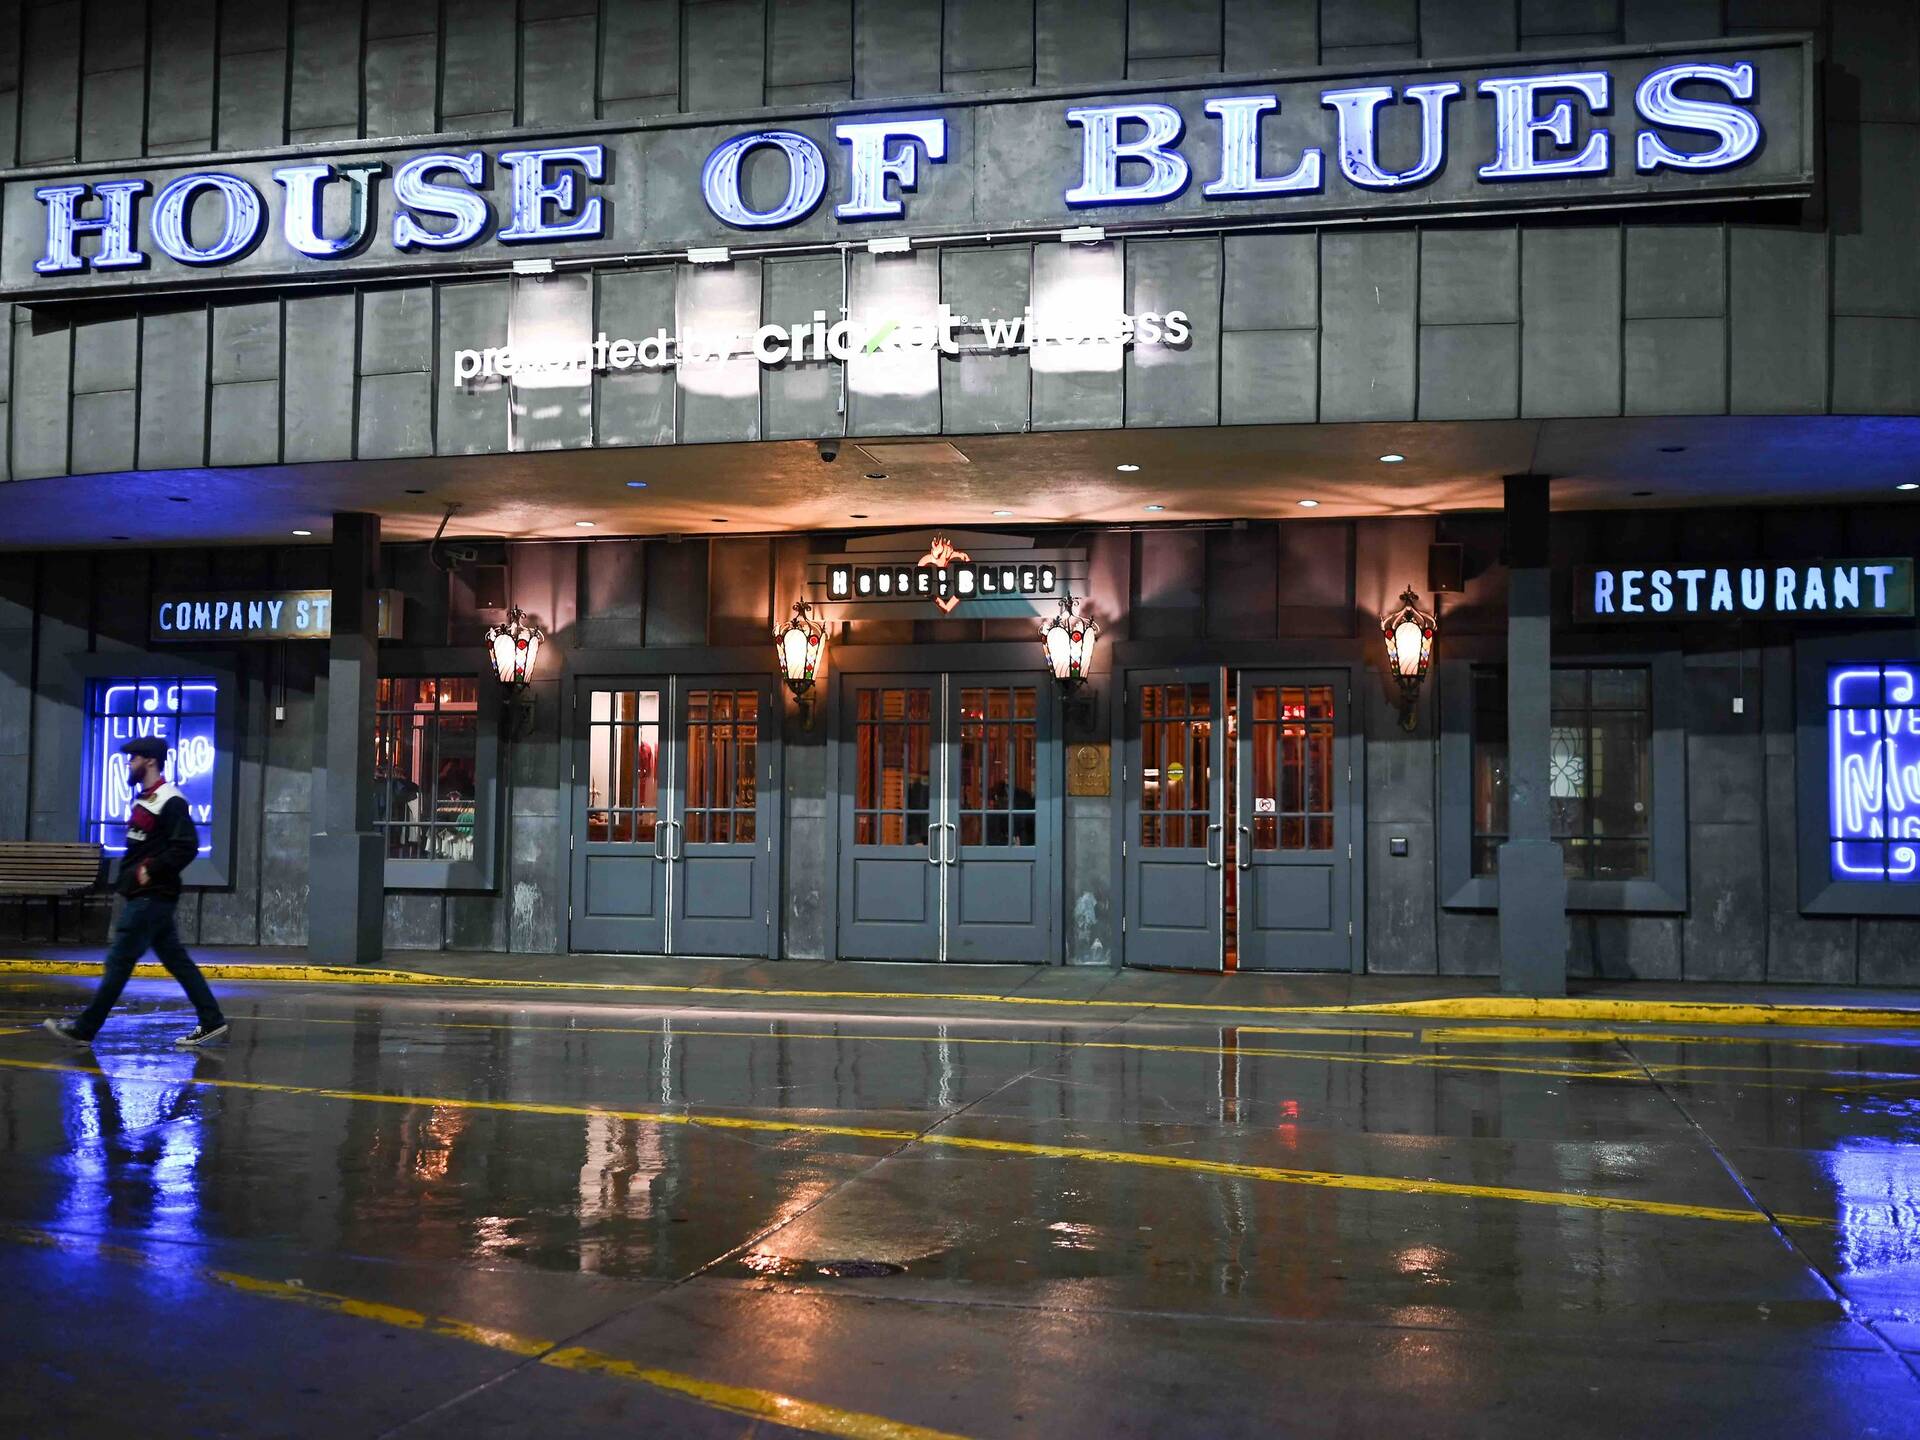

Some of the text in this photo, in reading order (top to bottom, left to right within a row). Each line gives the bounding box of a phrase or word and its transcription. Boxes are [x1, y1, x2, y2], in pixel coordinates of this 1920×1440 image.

[34, 62, 1761, 275] HOUSE OF BLUES
[1594, 566, 1894, 613] RESTAURANT
[159, 601, 283, 631] COMPANY
[113, 716, 167, 738] LIVE
[1847, 708, 1920, 735] LIVE
